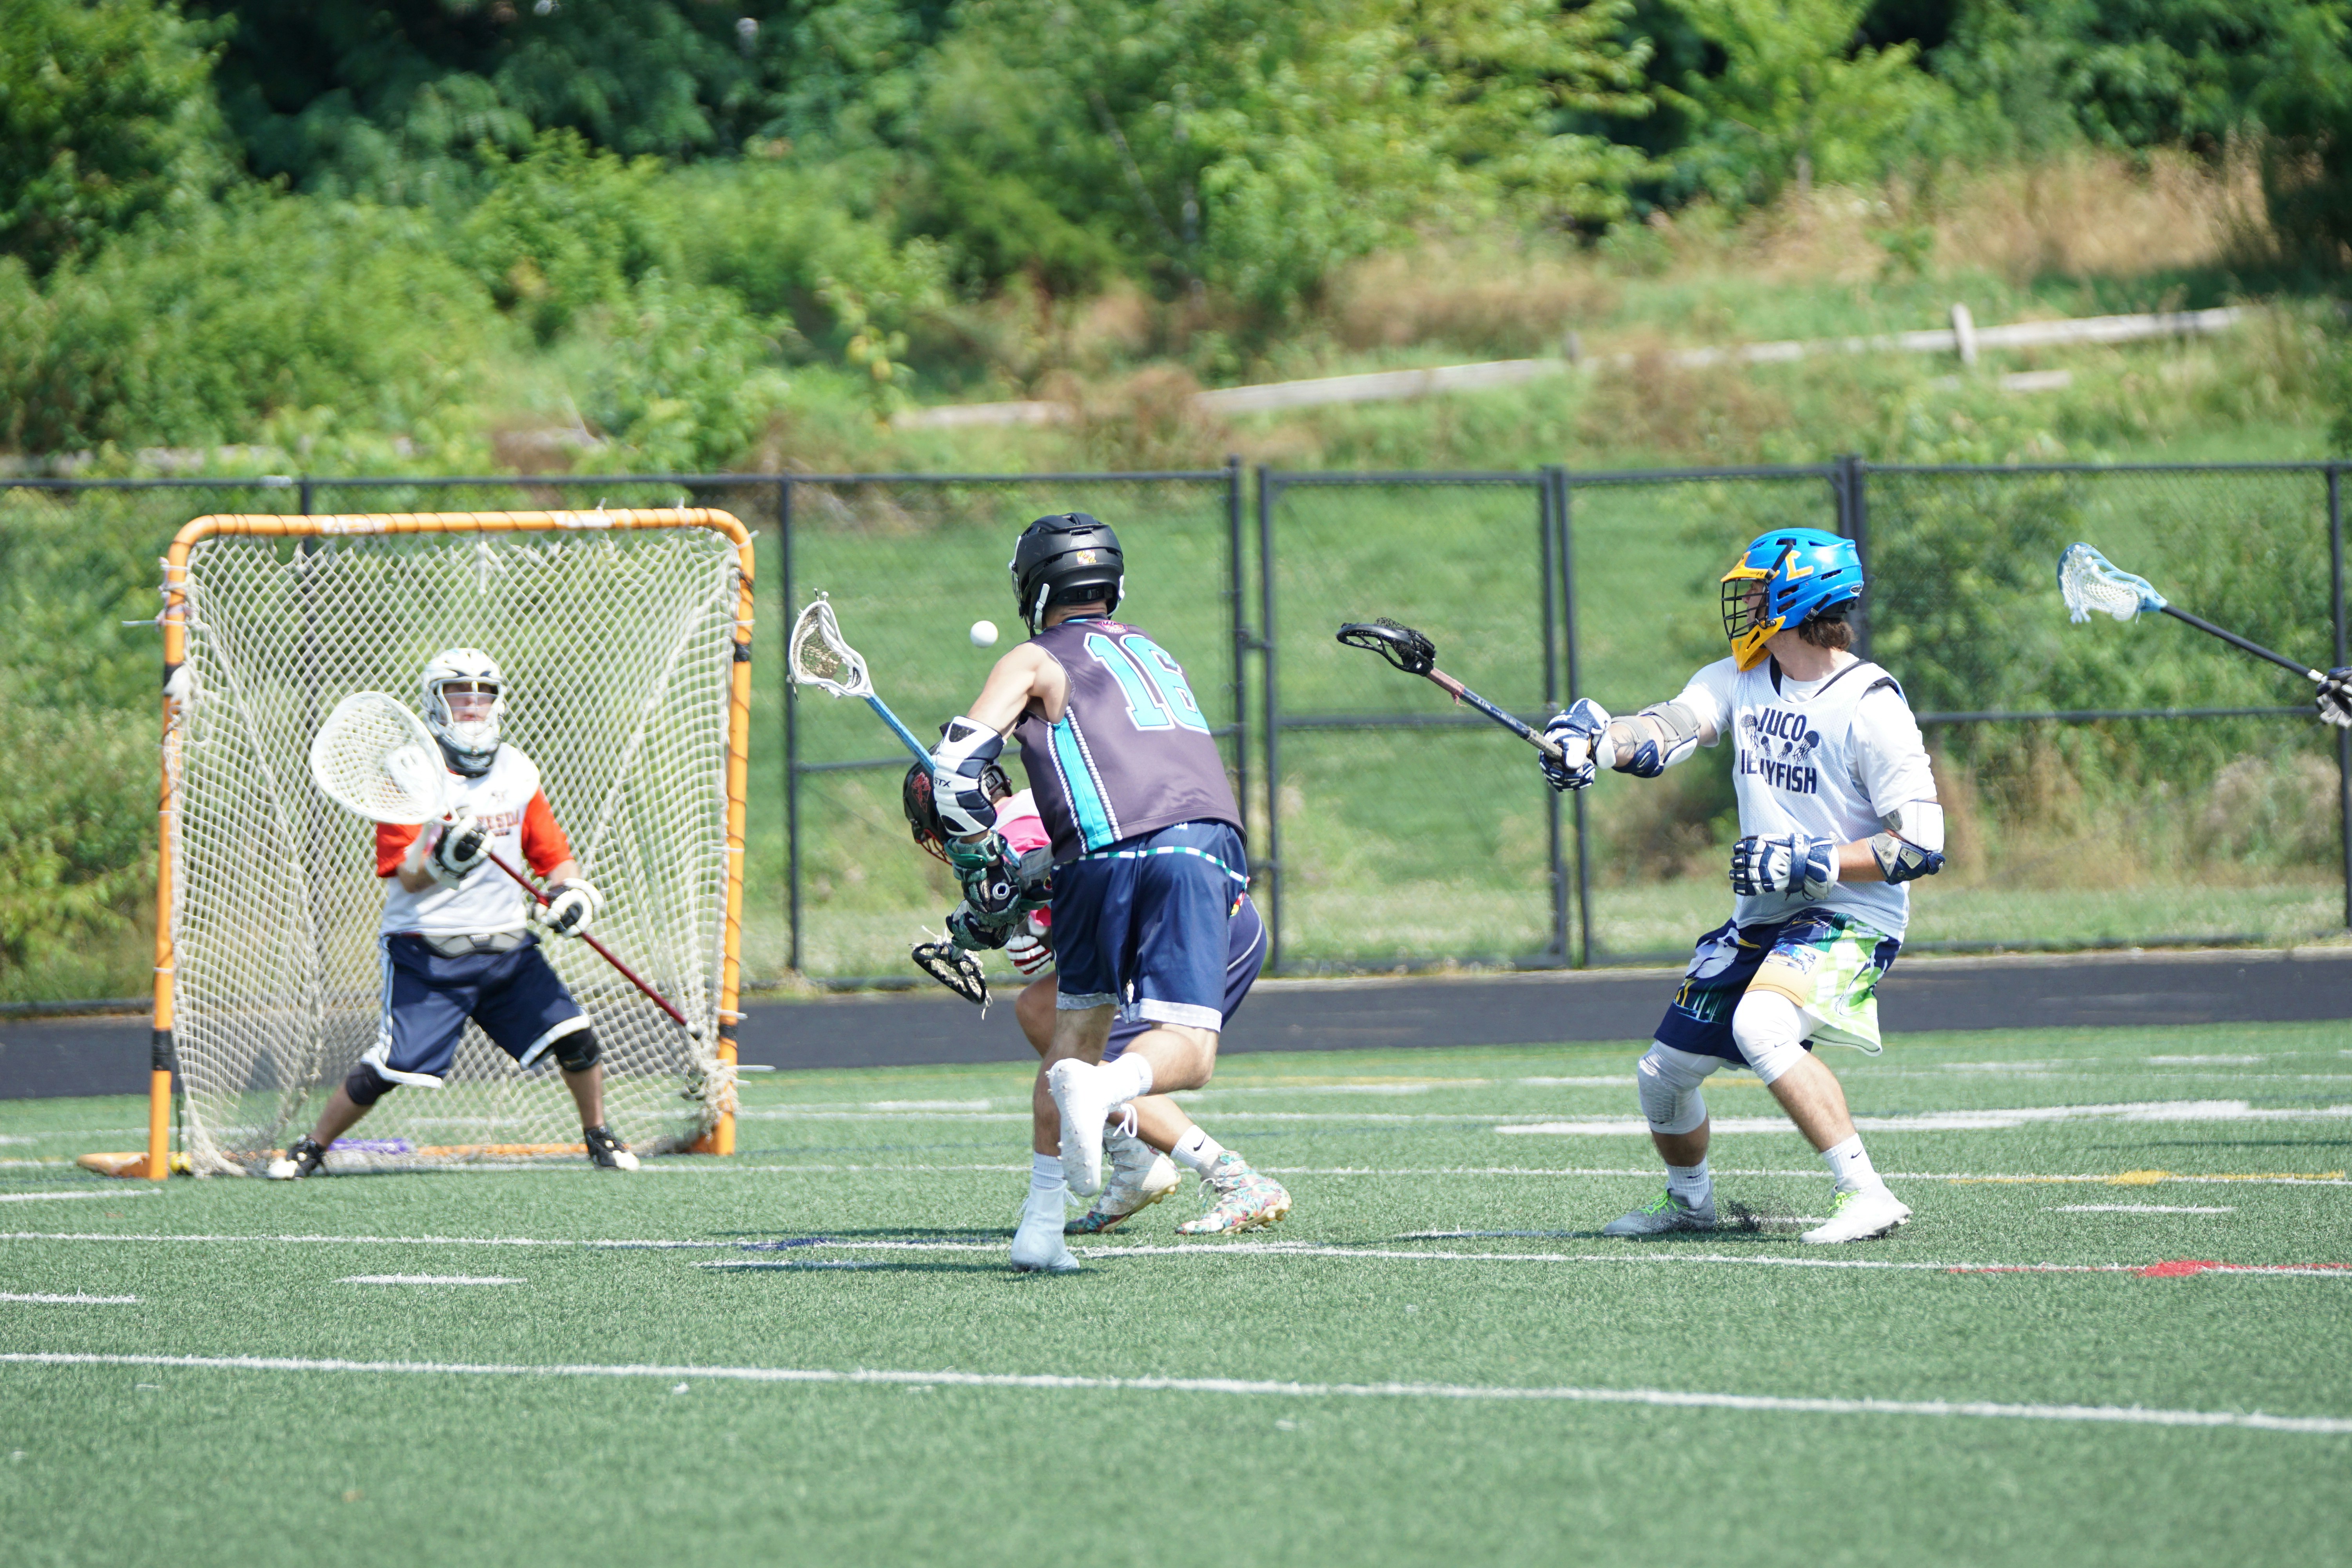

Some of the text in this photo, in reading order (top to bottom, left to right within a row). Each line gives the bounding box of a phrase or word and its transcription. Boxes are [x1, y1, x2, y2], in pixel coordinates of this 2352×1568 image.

[1083, 632, 1210, 735] 16
[1757, 707, 1807, 742] JUCO
[934, 776, 952, 788] STX
[1741, 749, 1817, 793] JELYFISH
